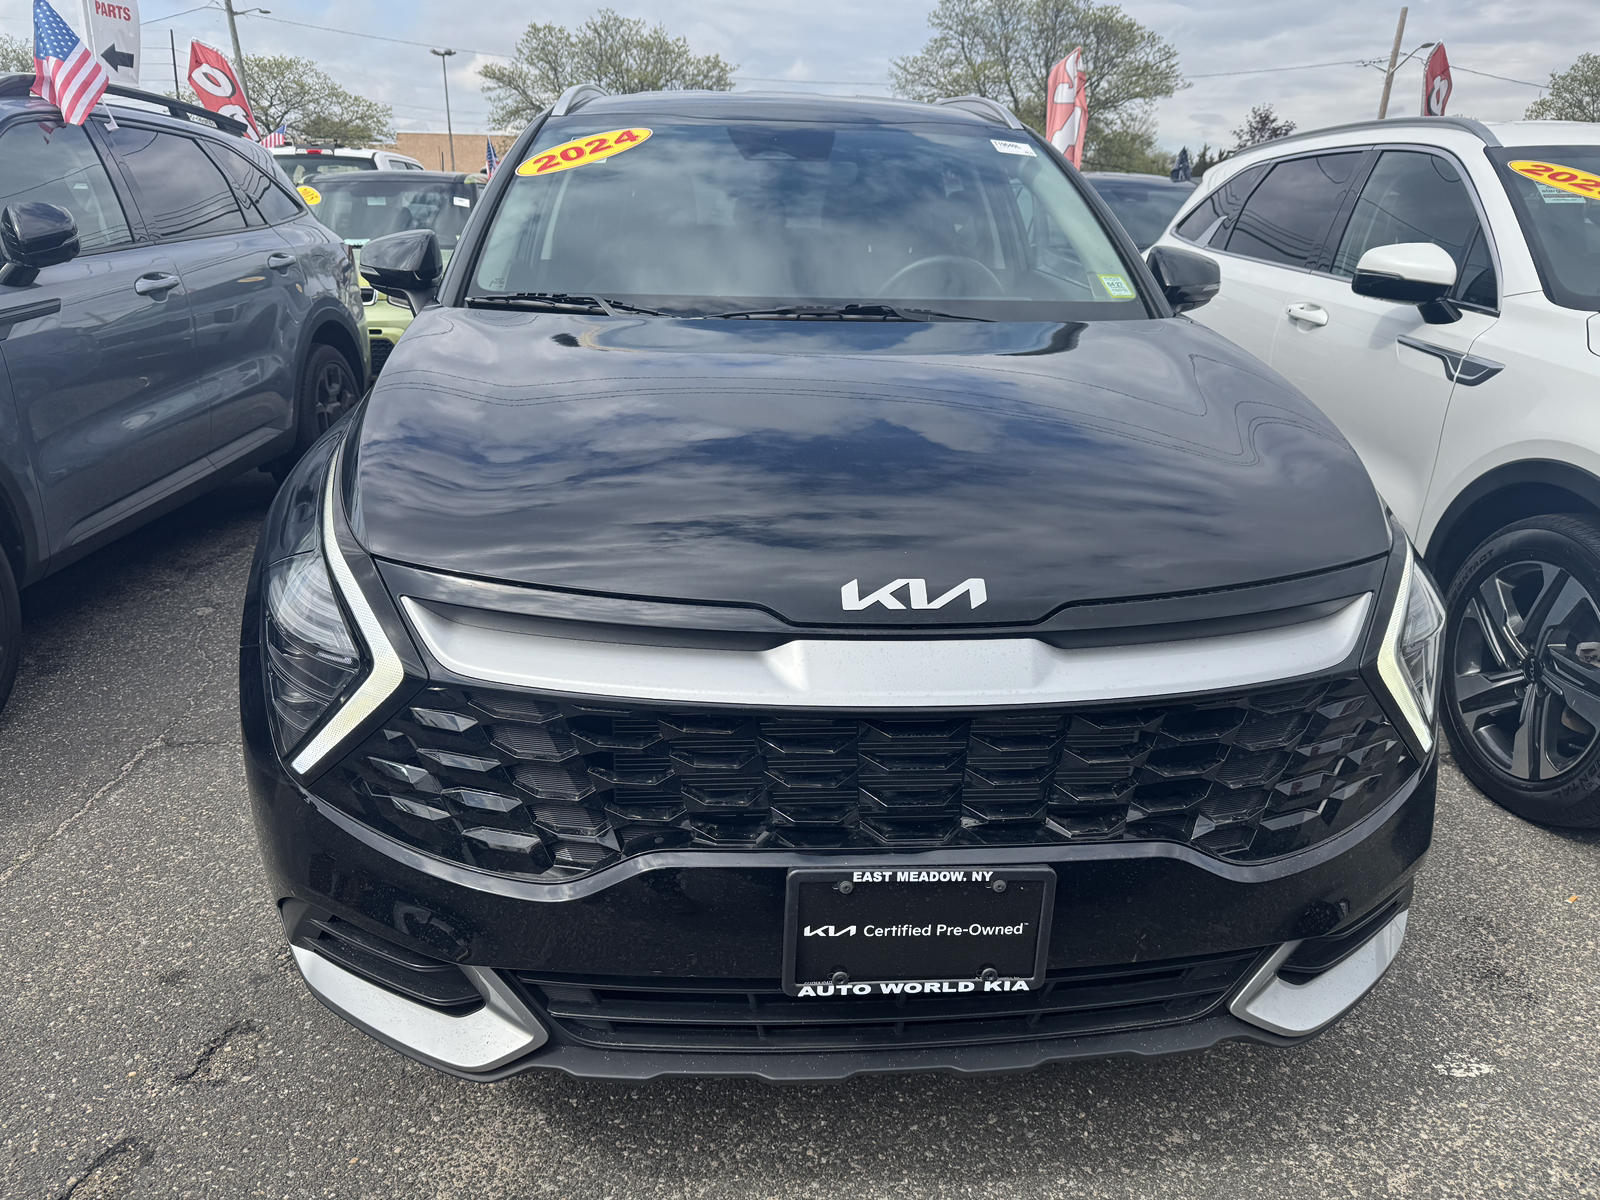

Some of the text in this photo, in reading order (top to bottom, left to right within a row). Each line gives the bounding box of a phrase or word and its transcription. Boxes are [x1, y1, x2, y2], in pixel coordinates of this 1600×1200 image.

[94, 0, 131, 22] PARTS
[533, 130, 641, 172] 2024
[1518, 164, 1600, 196] 202
[840, 578, 988, 611] KIA
[852, 871, 892, 883] EAST
[971, 871, 993, 882] NY
[803, 925, 857, 937] KIA
[863, 922, 931, 937] Certified
[797, 980, 1030, 998] AUTO WORLD KIA
